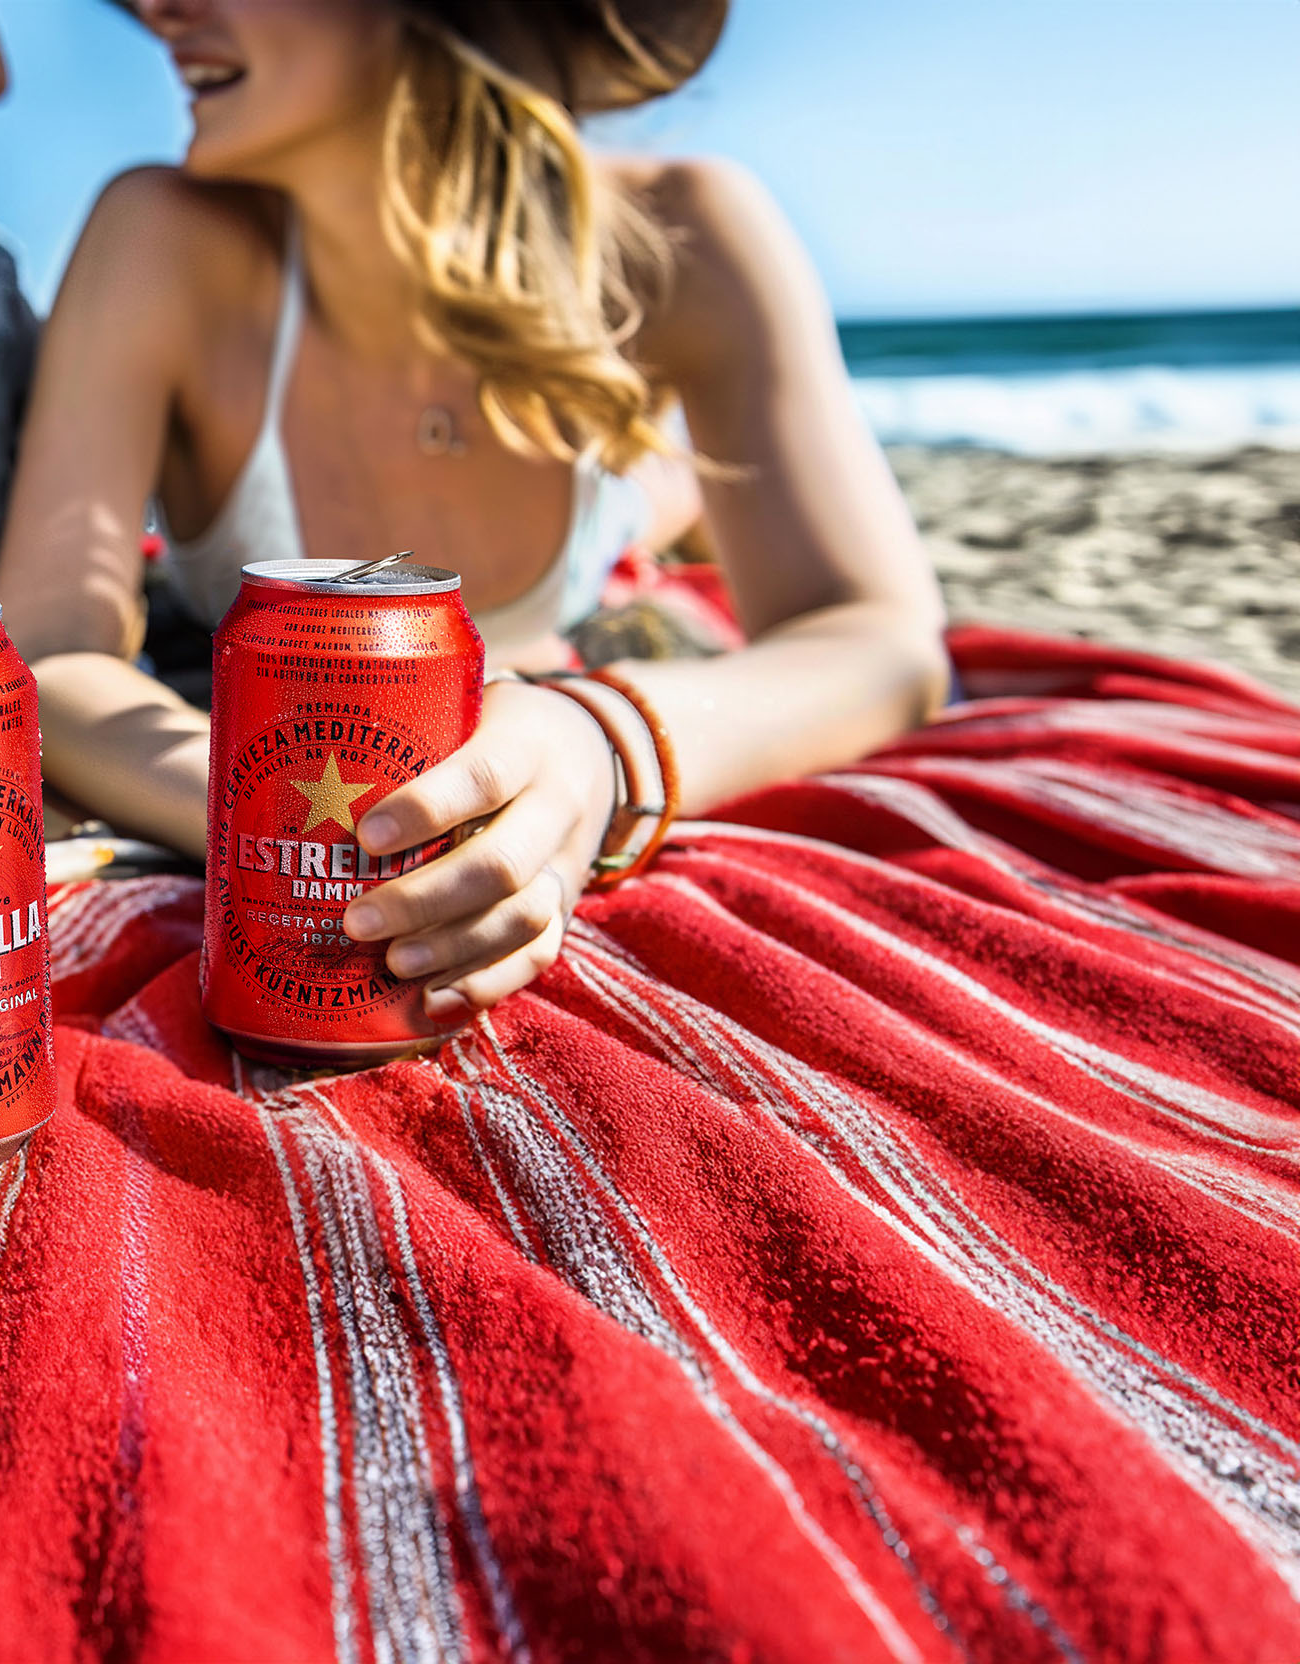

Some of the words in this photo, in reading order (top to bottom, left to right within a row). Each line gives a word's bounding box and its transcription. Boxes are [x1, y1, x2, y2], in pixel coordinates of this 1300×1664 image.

[331, 608, 364, 619] LOCALES
[284, 622, 299, 632] CON
[300, 624, 327, 635] ARROZ
[279, 654, 353, 671] INGREDIENTES
[358, 660, 417, 671] NATURALES
[256, 667, 270, 679] SIN
[273, 669, 319, 683] ADITIVOS
[324, 673, 334, 684] NI
[338, 674, 418, 686] CONSERVANTES
[297, 701, 371, 719] PREMIADA
[223, 728, 290, 810] CERVEZA
[294, 719, 429, 778] MEDITERRÁ
[243, 782, 257, 800] DE
[373, 758, 382, 770] Y
[0, 816, 6, 830] Y
[291, 879, 364, 902] DAMM
[246, 909, 316, 929] RECETA
[218, 877, 258, 967] AUGUST
[253, 962, 400, 1008] KUENTZMAN
[301, 932, 351, 947] 1876
[284, 1008, 349, 1022] STOCKHOLM
